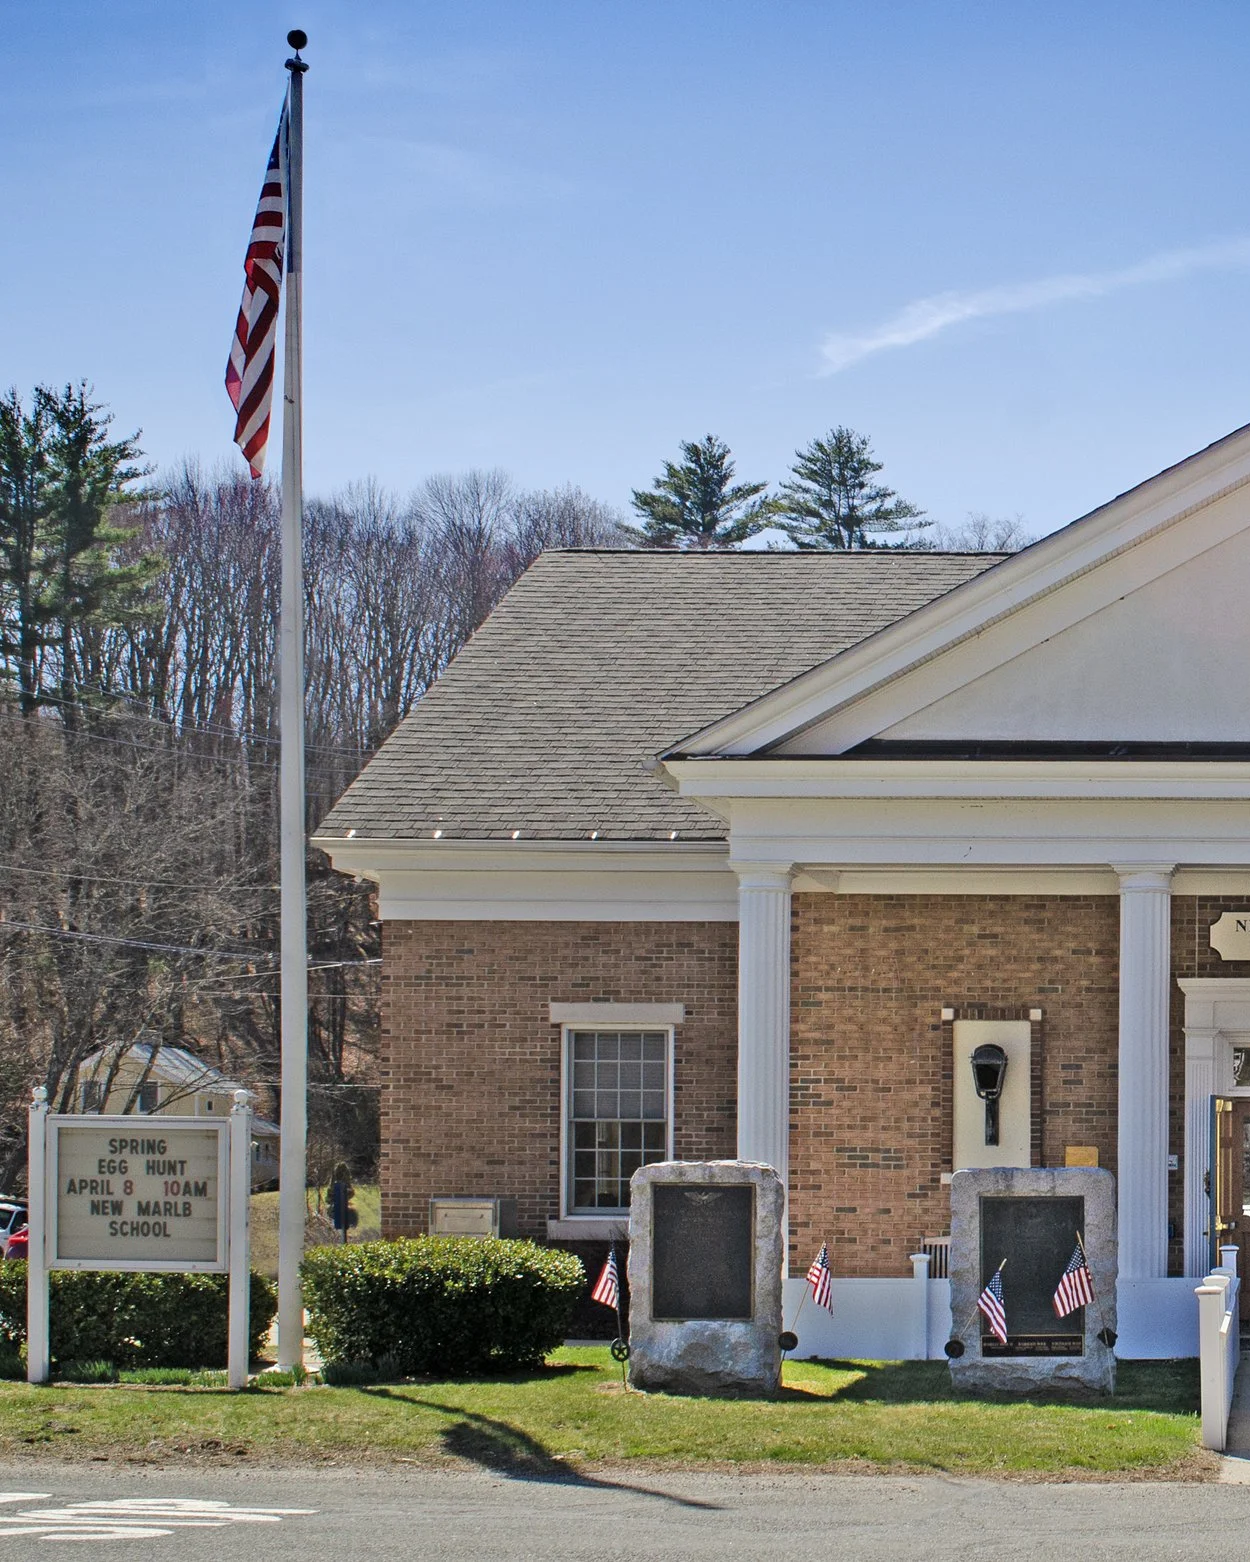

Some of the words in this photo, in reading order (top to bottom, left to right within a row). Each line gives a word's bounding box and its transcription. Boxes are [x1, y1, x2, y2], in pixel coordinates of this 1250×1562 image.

[109, 1139, 167, 1155] SPRING
[98, 1159, 128, 1175] EGG
[146, 1159, 187, 1176] HUNT
[66, 1179, 114, 1196] APRIL
[123, 1180, 134, 1196] 8
[164, 1181, 208, 1197] 10AM
[90, 1200, 123, 1216] NEW
[137, 1200, 192, 1217] MARLB
[109, 1221, 171, 1237] SCHOOL
